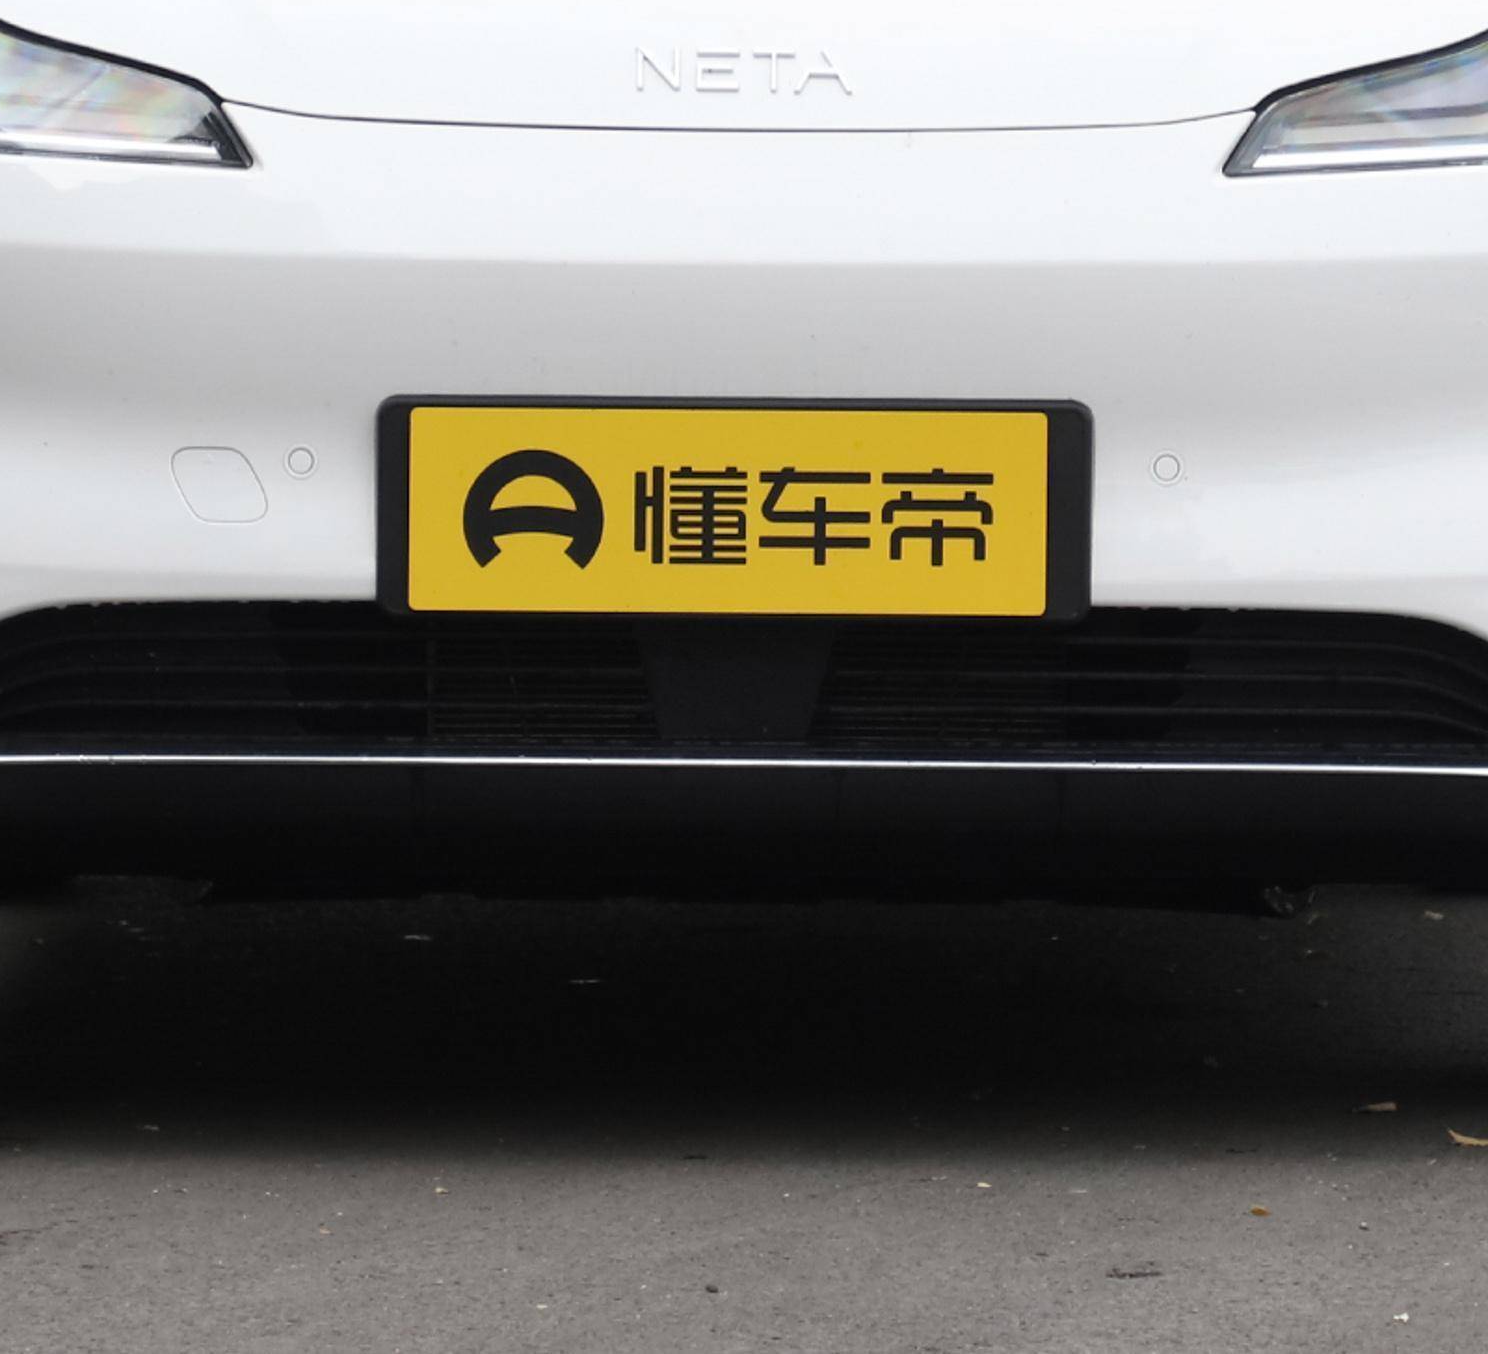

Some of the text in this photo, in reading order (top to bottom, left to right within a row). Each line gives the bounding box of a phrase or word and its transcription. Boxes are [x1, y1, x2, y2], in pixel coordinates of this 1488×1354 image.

[635, 46, 853, 96] NETA
[633, 465, 994, 567] 懂车帝
